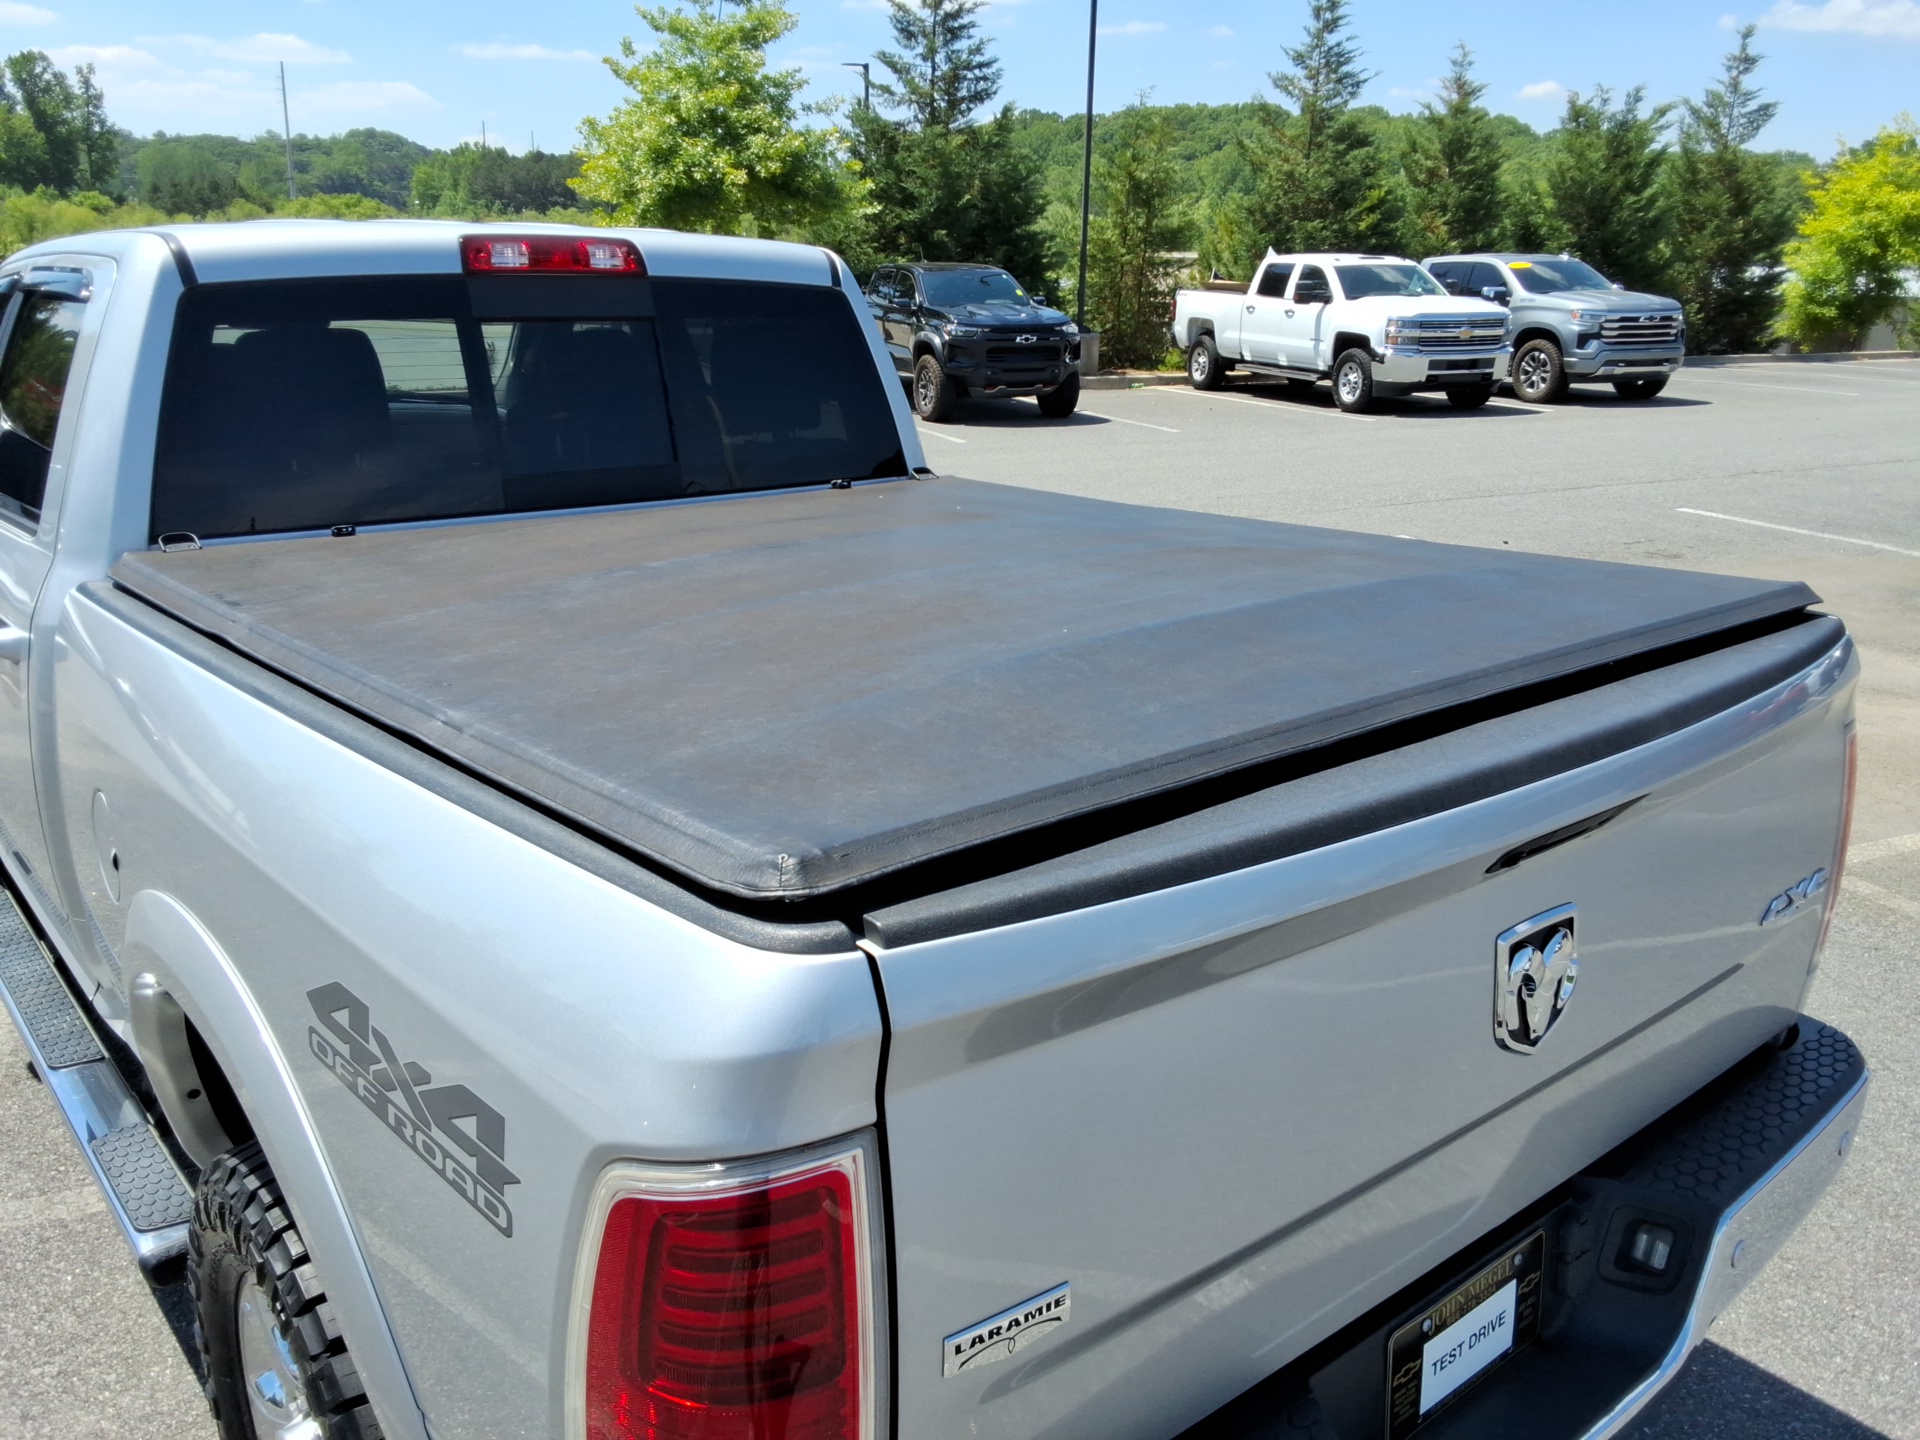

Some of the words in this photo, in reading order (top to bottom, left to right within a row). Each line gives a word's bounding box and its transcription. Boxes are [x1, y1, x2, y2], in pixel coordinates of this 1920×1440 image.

[311, 1031, 380, 1105] OFF
[387, 1102, 508, 1229] ROAD
[954, 1294, 1067, 1356] LARAMIE
[1428, 1291, 1466, 1336] JOHN
[1468, 1259, 1514, 1298] MEGEL
[1431, 1341, 1465, 1376] TEST
[1468, 1309, 1507, 1351] DRIVE
